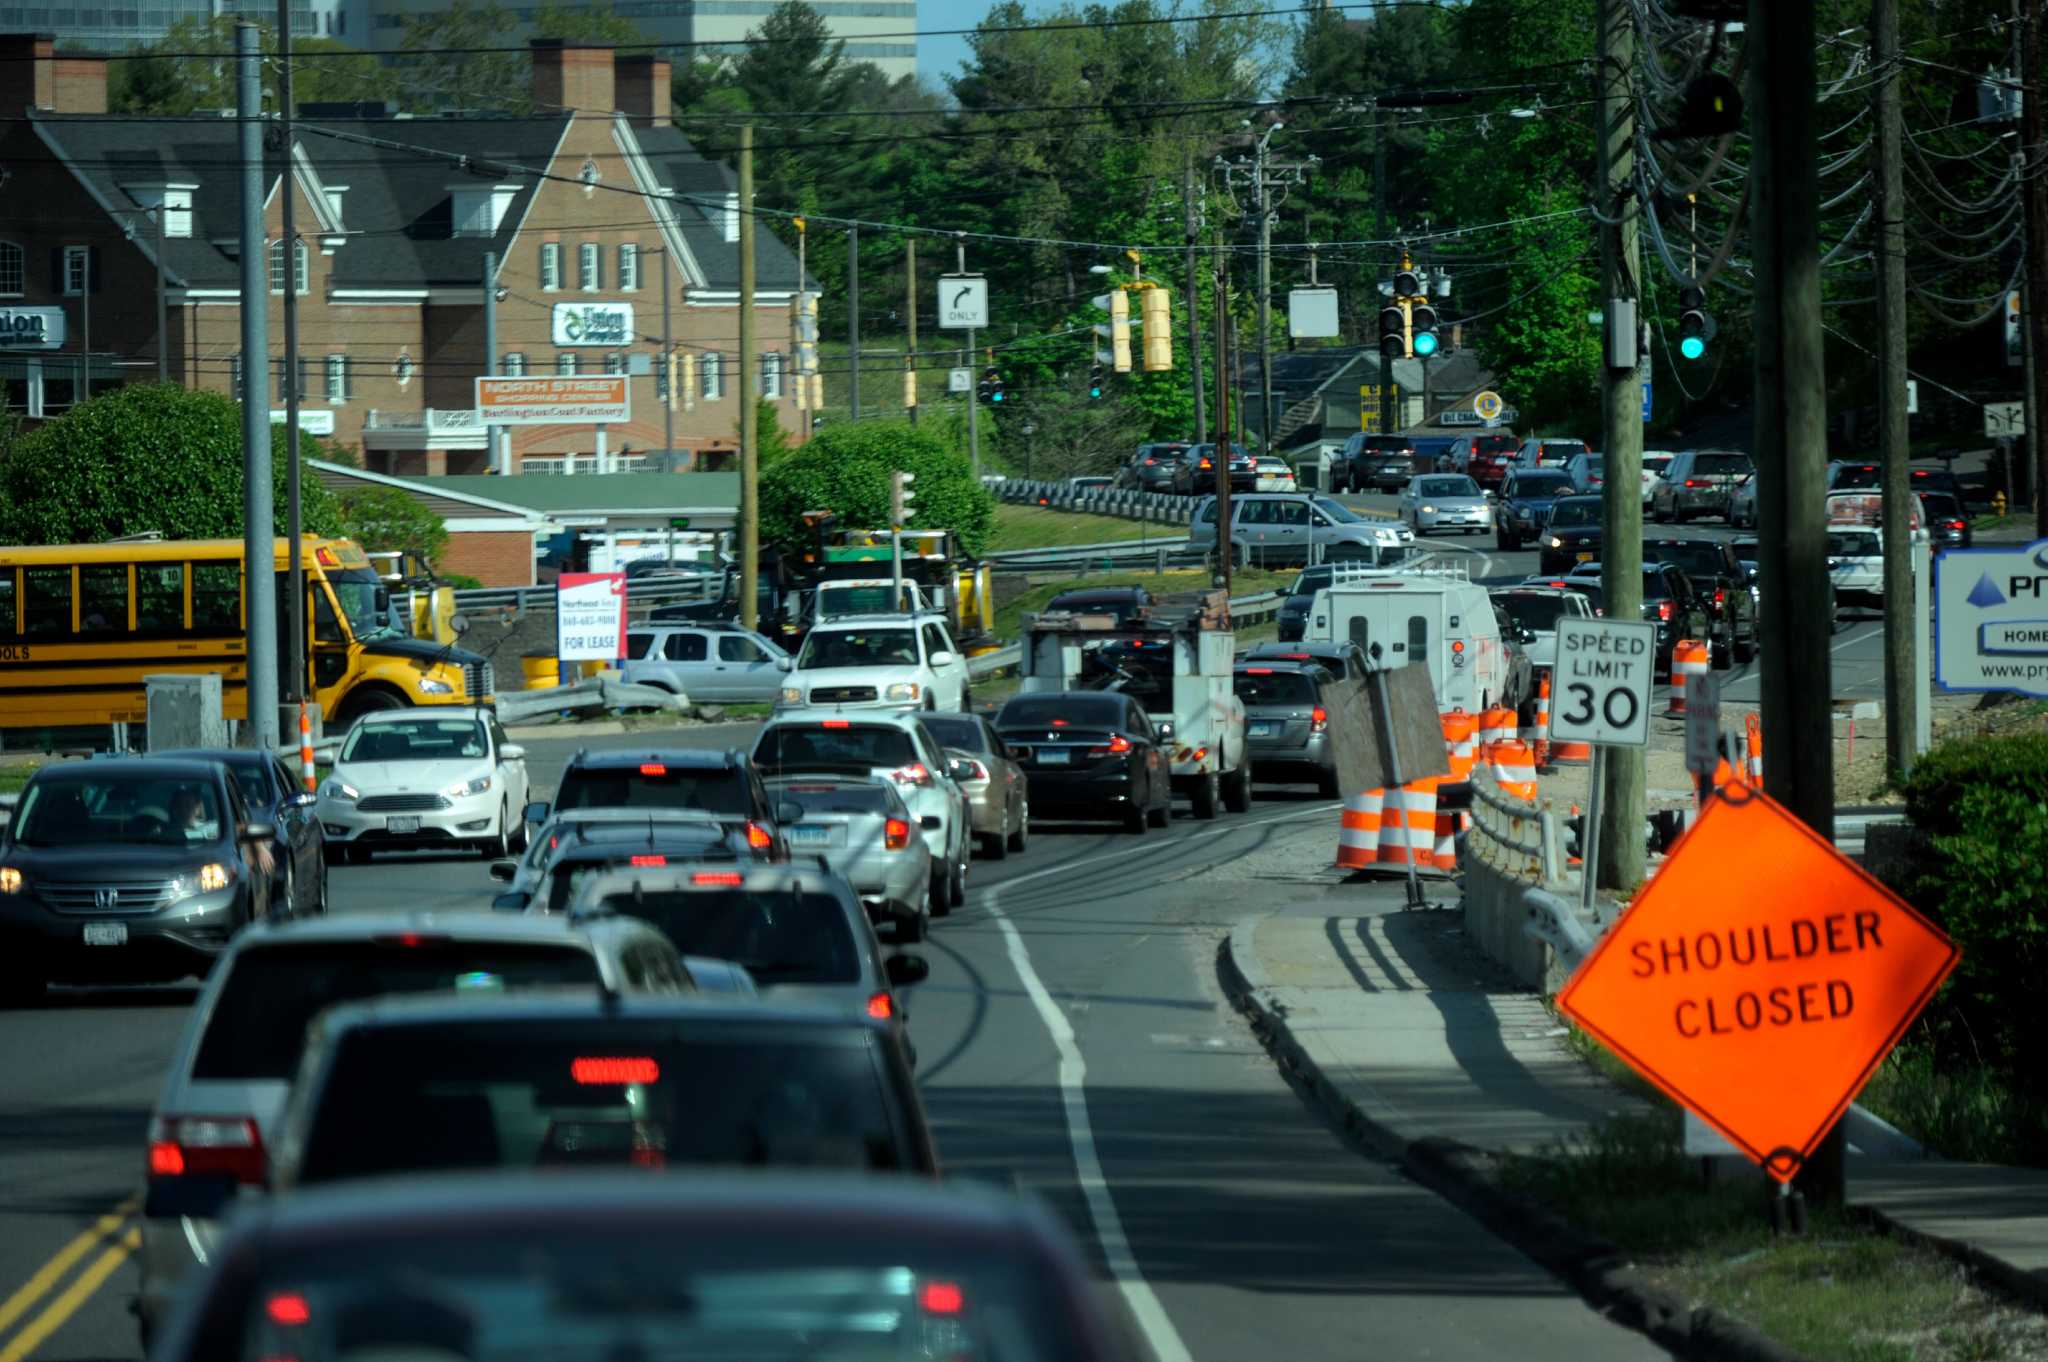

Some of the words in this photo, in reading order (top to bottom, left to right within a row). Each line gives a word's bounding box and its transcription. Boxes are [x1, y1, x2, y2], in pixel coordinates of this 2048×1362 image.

[948, 312, 978, 321] ONLY
[484, 382, 548, 393] NORTH
[551, 380, 621, 391] STREET
[564, 636, 584, 649] FOR
[587, 635, 615, 648] LEASE
[1566, 633, 1645, 656] SPEED
[1573, 658, 1634, 680] LIMIT
[1562, 682, 1639, 730] 30
[1630, 910, 1884, 979] SHOULDER
[1674, 979, 1855, 1039] CLOSED
